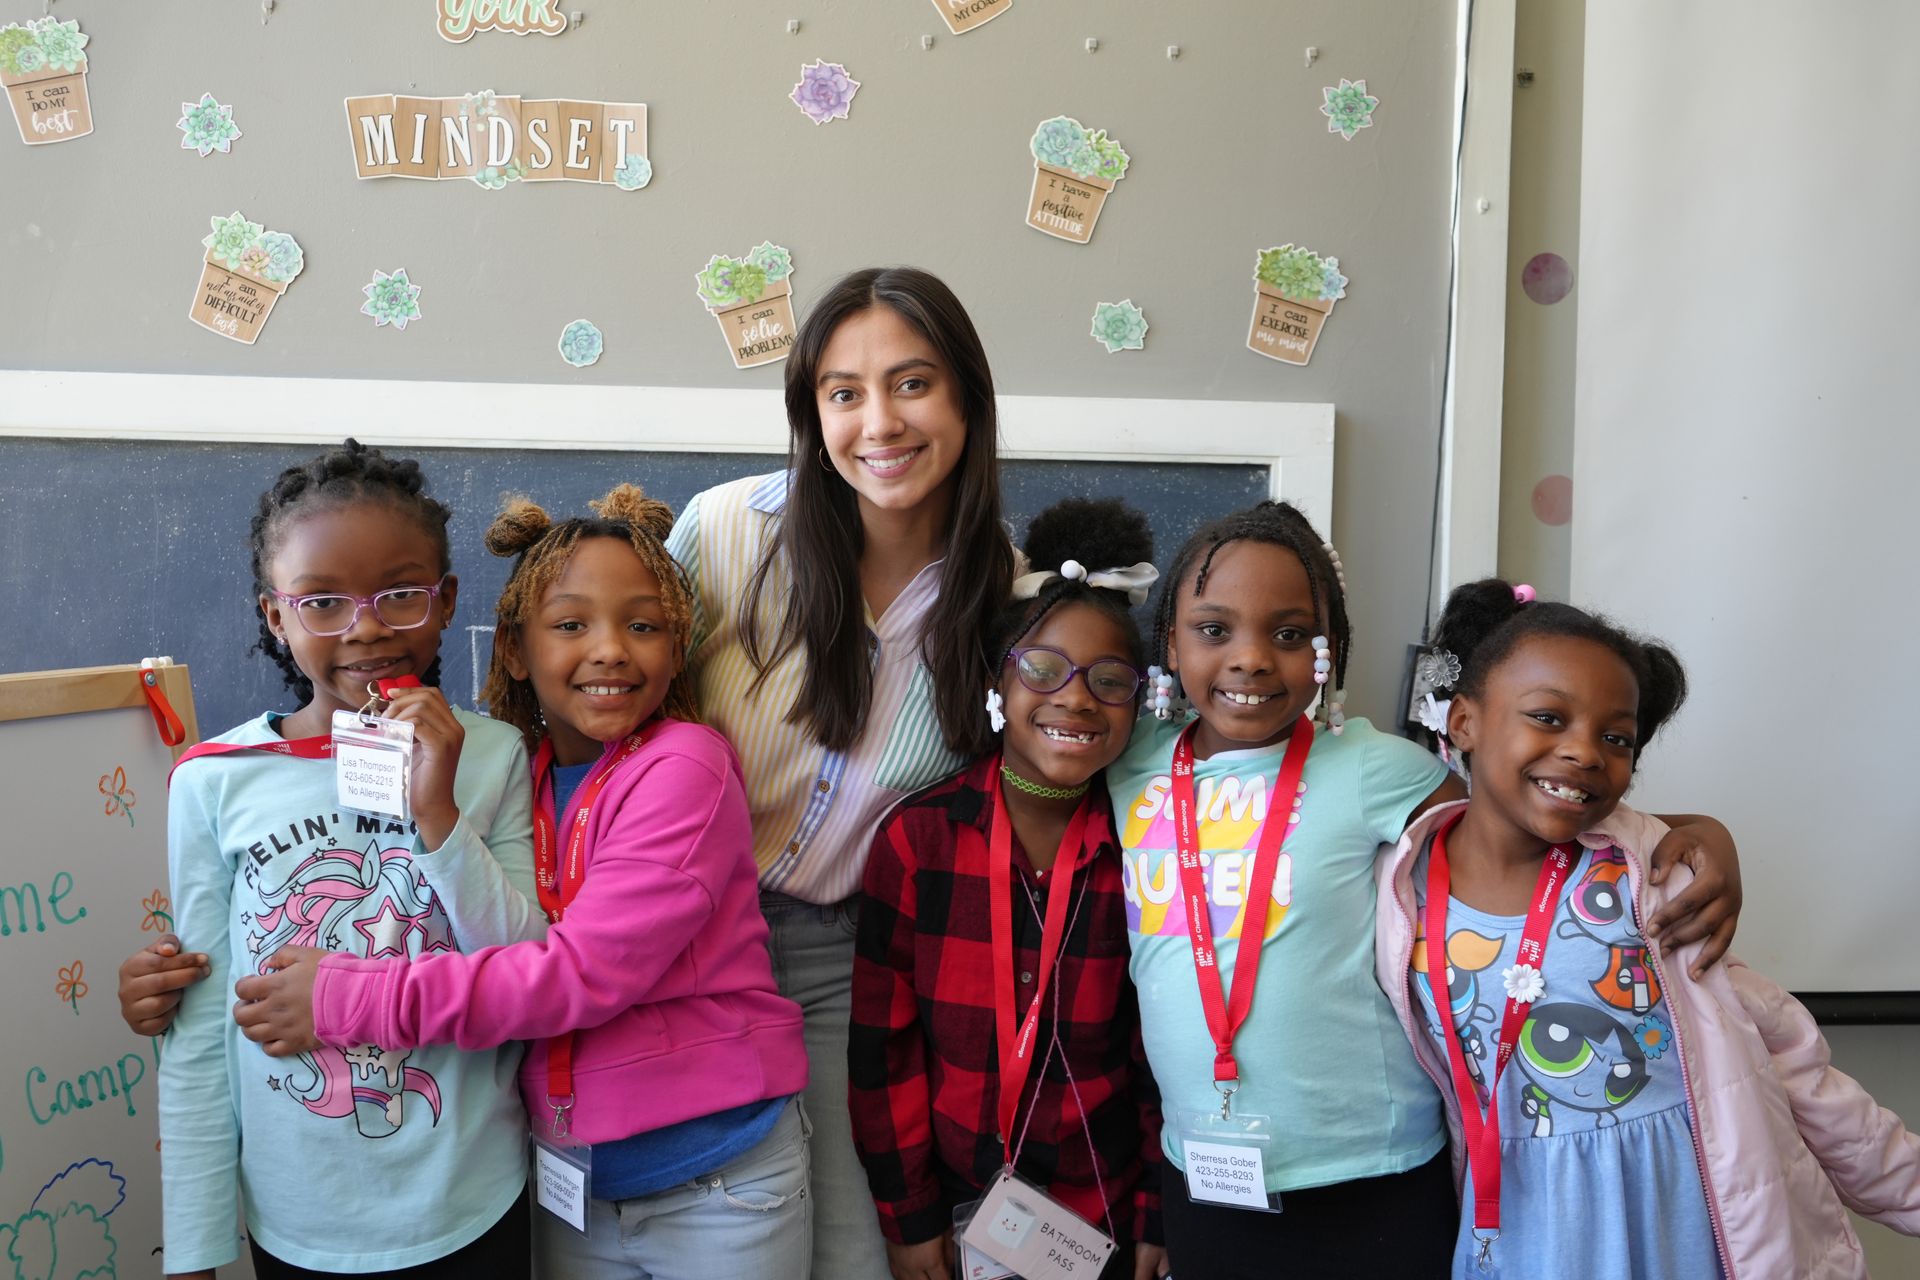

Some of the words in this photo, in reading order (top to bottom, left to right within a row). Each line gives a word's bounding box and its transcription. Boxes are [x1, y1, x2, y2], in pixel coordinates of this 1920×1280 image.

[954, 6, 970, 22] MY
[25, 90, 34, 100] I
[43, 86, 70, 97] can
[32, 101, 48, 112] DO
[50, 98, 66, 108] MY
[32, 109, 78, 134] best
[359, 113, 635, 170] MINDSET
[1049, 179, 1056, 188] I
[1062, 182, 1091, 198] have
[1063, 194, 1070, 202] a
[1033, 210, 1085, 236] ATTITUDE
[206, 282, 226, 292] not
[224, 276, 233, 286] I
[239, 284, 256, 296] am
[204, 294, 258, 324] DIFFICULT
[738, 315, 745, 324] I
[752, 308, 774, 320] can
[1270, 304, 1279, 314] I
[1284, 310, 1308, 324] can
[742, 318, 783, 347] solve
[1260, 316, 1309, 339] EXERCISE
[738, 334, 794, 359] PROBLEMS
[1256, 331, 1274, 346] my
[1280, 338, 1309, 354] mind
[342, 757, 356, 766] Lisa
[359, 759, 396, 773] Thompson
[1174, 761, 1184, 776] girls
[344, 771, 394, 787] 423-605-2215
[348, 785, 358, 795] No
[360, 787, 390, 801] Allergies
[1182, 850, 1192, 868] girls
[1189, 852, 1198, 868] inc.
[1539, 878, 1556, 912] Chattanooga
[1192, 895, 1201, 933] Chattanooga
[1521, 938, 1531, 954] inc.
[1529, 941, 1541, 962] girls
[1194, 947, 1206, 968] girls
[1204, 950, 1214, 966] inc.
[1018, 1022, 1033, 1058] Chattanooga
[1190, 1152, 1228, 1164] Sherresa
[1230, 1156, 1256, 1168] Gober
[1196, 1166, 1254, 1181] 423-255-8293
[1201, 1180, 1214, 1188] No
[1216, 1182, 1252, 1194] Allergies
[546, 1186, 554, 1198] No
[554, 1192, 573, 1211] Allergies
[1040, 1222, 1102, 1266] BATHROOM
[1048, 1250, 1075, 1272] PASS
